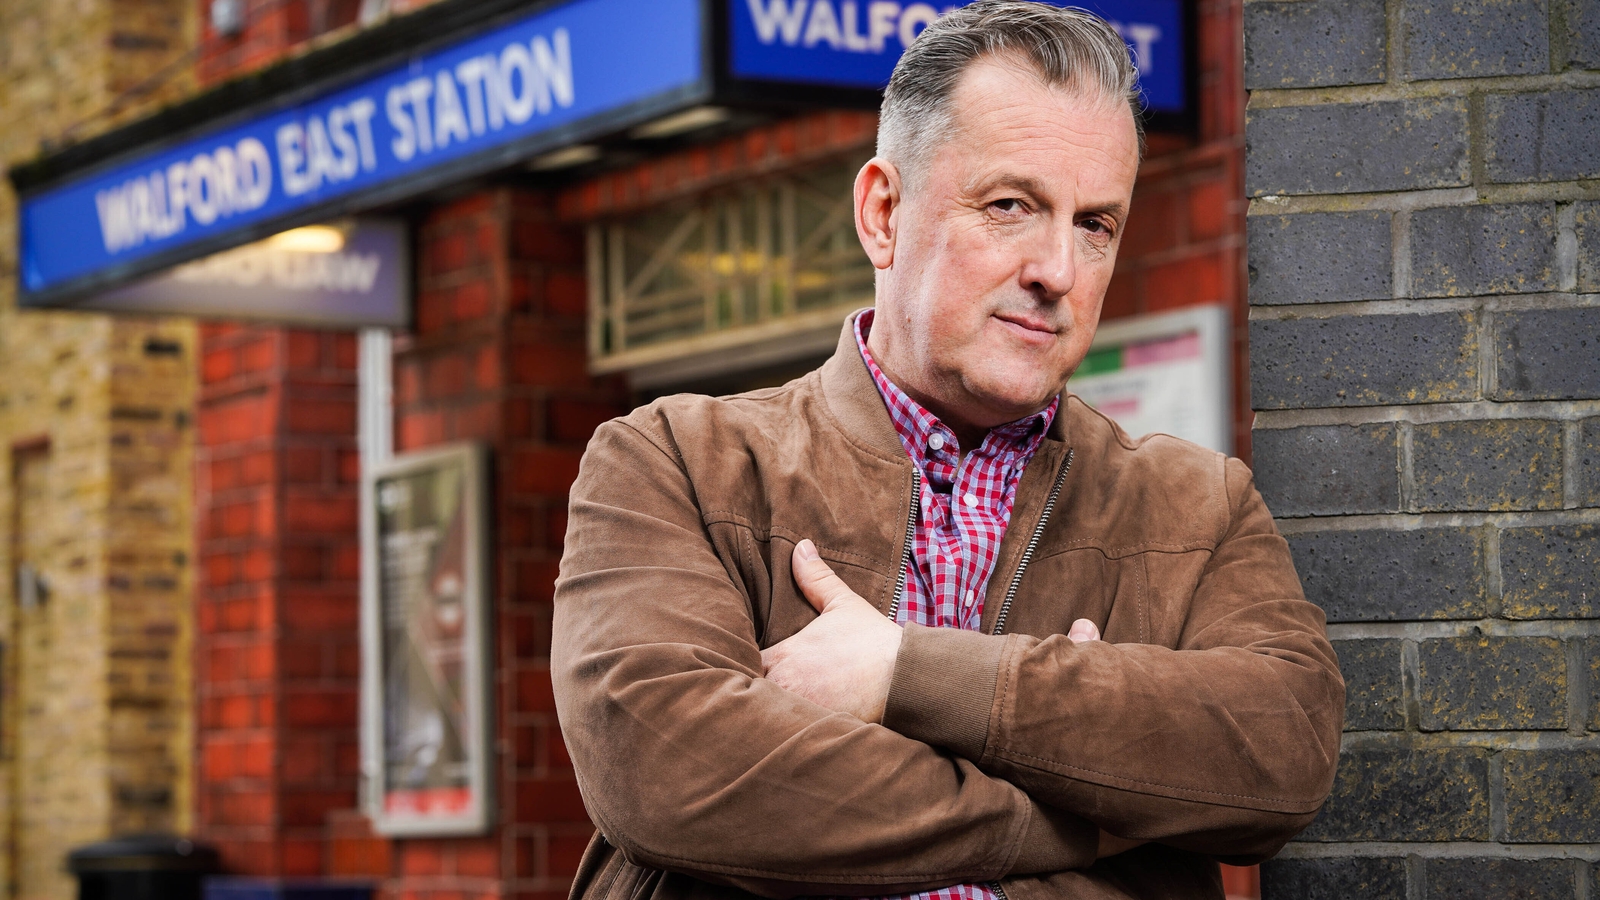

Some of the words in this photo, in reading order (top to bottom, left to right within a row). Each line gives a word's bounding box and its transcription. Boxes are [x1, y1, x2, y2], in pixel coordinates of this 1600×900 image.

[746, 0, 958, 54] WALFO
[95, 136, 272, 255] WALFORD
[275, 96, 378, 197] EAST
[385, 27, 575, 162] STATION
